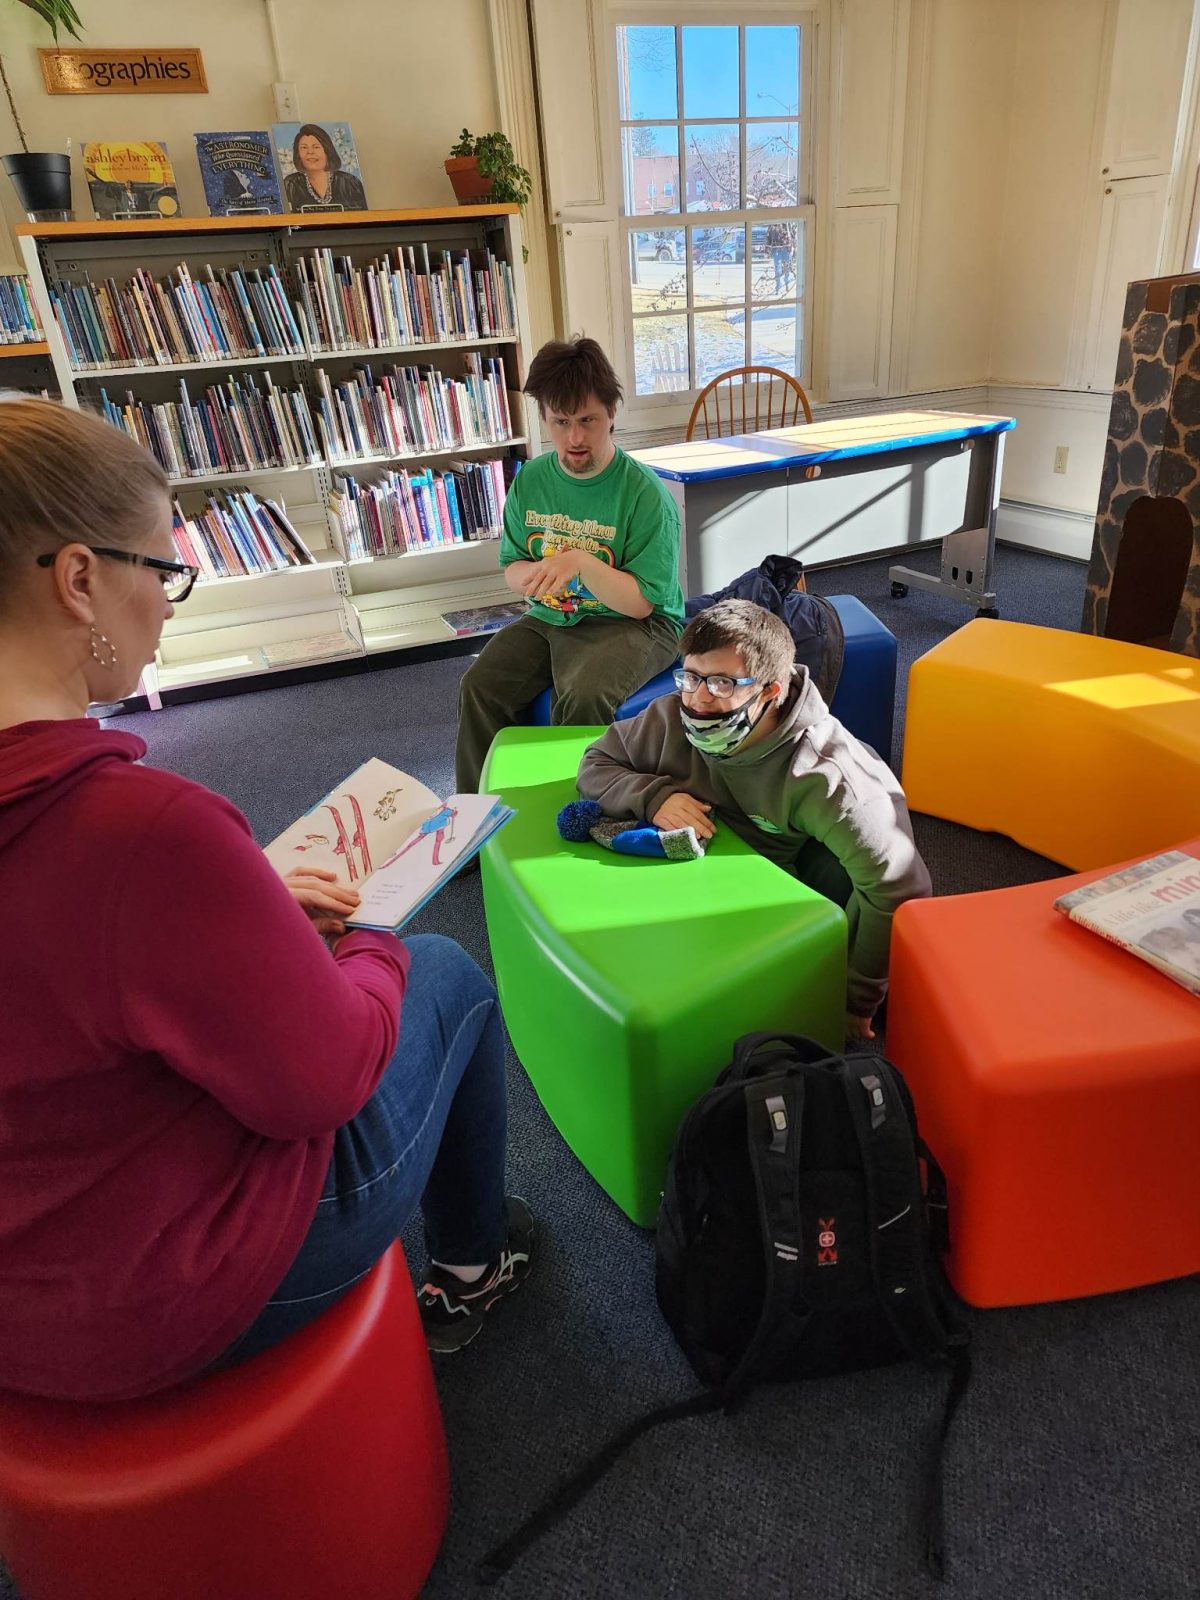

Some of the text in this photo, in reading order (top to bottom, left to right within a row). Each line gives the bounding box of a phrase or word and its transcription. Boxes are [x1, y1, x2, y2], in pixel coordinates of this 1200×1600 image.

[54, 55, 191, 87] ographies
[86, 147, 166, 166] ashley bryan
[213, 141, 268, 154] ASTRONOMER
[212, 161, 266, 174] EVERYTHING
[526, 511, 584, 536] Everthing
[1150, 874, 1200, 903] min
